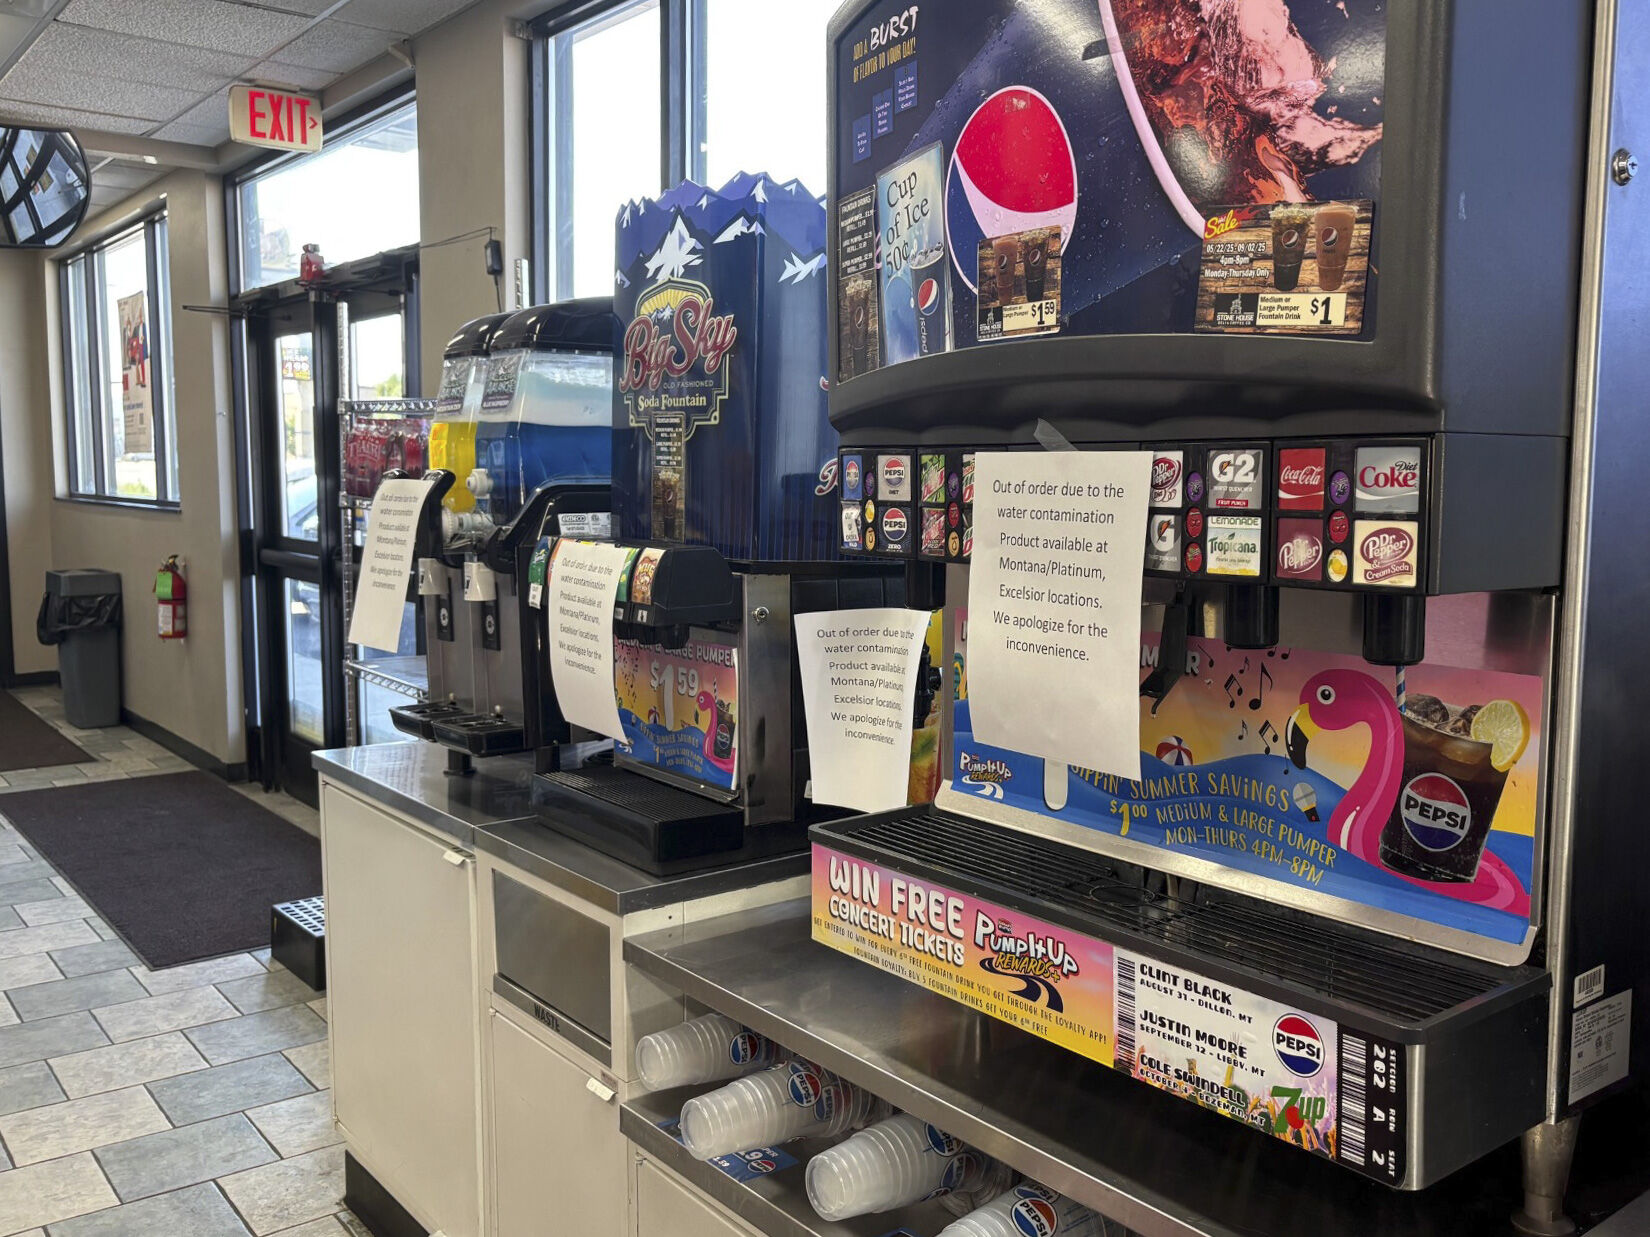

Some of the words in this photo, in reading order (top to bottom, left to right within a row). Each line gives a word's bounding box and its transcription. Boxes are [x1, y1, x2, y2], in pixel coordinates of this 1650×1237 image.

[248, 91, 310, 144] EXIT
[886, 170, 918, 208] Cup
[886, 212, 900, 246] of
[904, 197, 930, 231] Ice
[1204, 209, 1239, 240] Sale
[885, 240, 909, 279] 50¢
[1220, 254, 1250, 266] 4pm-8pm
[1256, 268, 1270, 279] Only
[1260, 296, 1281, 304] Medium
[1260, 304, 1275, 312] Large
[1310, 296, 1332, 325] $1
[1258, 312, 1283, 320] Fountain
[1284, 312, 1301, 320] Drink
[618, 314, 668, 394] Big
[663, 296, 737, 377] Sky
[678, 380, 714, 388] FASHIONED
[638, 395, 659, 411] Soda
[661, 393, 706, 410] Fountain
[1160, 462, 1168, 471] Dr
[1212, 453, 1256, 483] G2
[1359, 466, 1417, 488] Coke
[1394, 460, 1418, 472] Diet
[993, 480, 1012, 494] Out
[1014, 480, 1025, 494] of
[1028, 481, 1058, 496] order
[1061, 482, 1084, 497] due
[1087, 484, 1100, 498] to
[1104, 483, 1124, 498] the
[997, 507, 1027, 520] water
[1030, 508, 1115, 524] contamination
[1210, 516, 1259, 526] LEMONADE
[1000, 532, 1040, 548] Product
[1042, 536, 1092, 552] available
[1096, 540, 1109, 554] at
[1208, 536, 1258, 554] Tropicana
[1368, 536, 1406, 560] Pepper
[1380, 534, 1396, 545] Dr
[604, 566, 613, 576] the
[999, 557, 1106, 582] Montana/Platinum,
[1366, 567, 1390, 580] Cream
[1390, 562, 1410, 574] Soda
[561, 575, 572, 584] water
[573, 576, 606, 590] contamination
[999, 584, 1046, 602] Excelsior
[1048, 588, 1103, 609] locations.
[816, 628, 836, 639] Out
[839, 627, 850, 638] of
[852, 628, 880, 637] order
[882, 627, 899, 638] due
[993, 610, 1010, 625] We
[1012, 614, 1064, 634] apologize
[1067, 620, 1084, 636] for
[1088, 623, 1108, 638] the
[566, 642, 586, 656] apologize
[586, 647, 594, 658] for
[594, 648, 602, 660] the
[824, 644, 854, 654] water
[858, 644, 909, 656] contamination
[1006, 636, 1090, 661] inconvenience.
[829, 662, 869, 671] Product
[871, 662, 901, 674] available
[834, 694, 874, 704] Excelsior
[876, 696, 902, 711] locations.
[831, 712, 848, 722] We
[850, 713, 886, 726] apologize
[886, 716, 895, 726] for
[845, 728, 896, 746] inconvenience.
[1130, 772, 1200, 800] SUMMER
[1208, 772, 1290, 813] SAVINGS
[1404, 795, 1467, 830] PEPSI
[1156, 804, 1212, 824] MEDIUM
[1218, 807, 1229, 823] &
[1234, 807, 1274, 838] LARGE
[1278, 824, 1337, 868] PUMPER
[1166, 826, 1247, 852] MON-THURS
[1251, 840, 1324, 888] 4PM-8PM
[829, 855, 880, 907] WIN
[891, 878, 965, 938] FREE
[829, 894, 896, 940] CONCERT
[900, 921, 965, 966] TICKETS
[995, 952, 1061, 984] REWARDS+
[824, 920, 846, 936] ENTERED
[848, 930, 854, 940] TO
[856, 934, 866, 946] WIN
[868, 939, 878, 950] FOR
[881, 943, 898, 958] EVERY
[910, 955, 922, 969] FREE
[924, 962, 953, 981] FOUNTAIN
[956, 974, 974, 990] DRINK
[977, 982, 991, 996] YOU
[993, 988, 1004, 1002] GET
[1008, 994, 1038, 1016] THROUGH
[1040, 1008, 1053, 1023] THE
[1056, 1014, 1086, 1036] LOYALTY
[1089, 1029, 1107, 1045] APP!
[854, 946, 880, 964] FOUNTAIN
[908, 968, 921, 982] BUY
[922, 976, 926, 984] 5
[928, 978, 958, 998] FOUNTAIN
[960, 990, 984, 1008] DRINKS
[986, 1002, 997, 1014] GET
[1000, 1008, 1018, 1025] YOUR
[1032, 1022, 1048, 1036] FREE
[1140, 963, 1180, 987] CLINT
[1184, 978, 1232, 1006] BLACK
[1140, 978, 1174, 996] AUGUST
[1177, 991, 1188, 1001] 31
[1238, 1013, 1254, 1024] MT
[534, 1002, 560, 1033] WASTE
[1140, 1010, 1191, 1038] JUSTIN
[1195, 1030, 1248, 1060] MOORE
[1276, 1032, 1321, 1060] PEPSI
[740, 1034, 748, 1063] PEPSI
[1140, 1024, 1192, 1050] SEPTEMBER
[1195, 1044, 1206, 1054] 12
[1251, 1066, 1266, 1078] MT
[1373, 1044, 1386, 1090] 202
[796, 1074, 812, 1104] PEPSI
[1140, 1054, 1172, 1076] COLE
[1174, 1068, 1246, 1108] SWINDELL
[1140, 1068, 1179, 1090] OCTOBER
[1250, 1114, 1266, 1126] MT
[1372, 1106, 1386, 1122] A
[1372, 1150, 1384, 1166] 2
